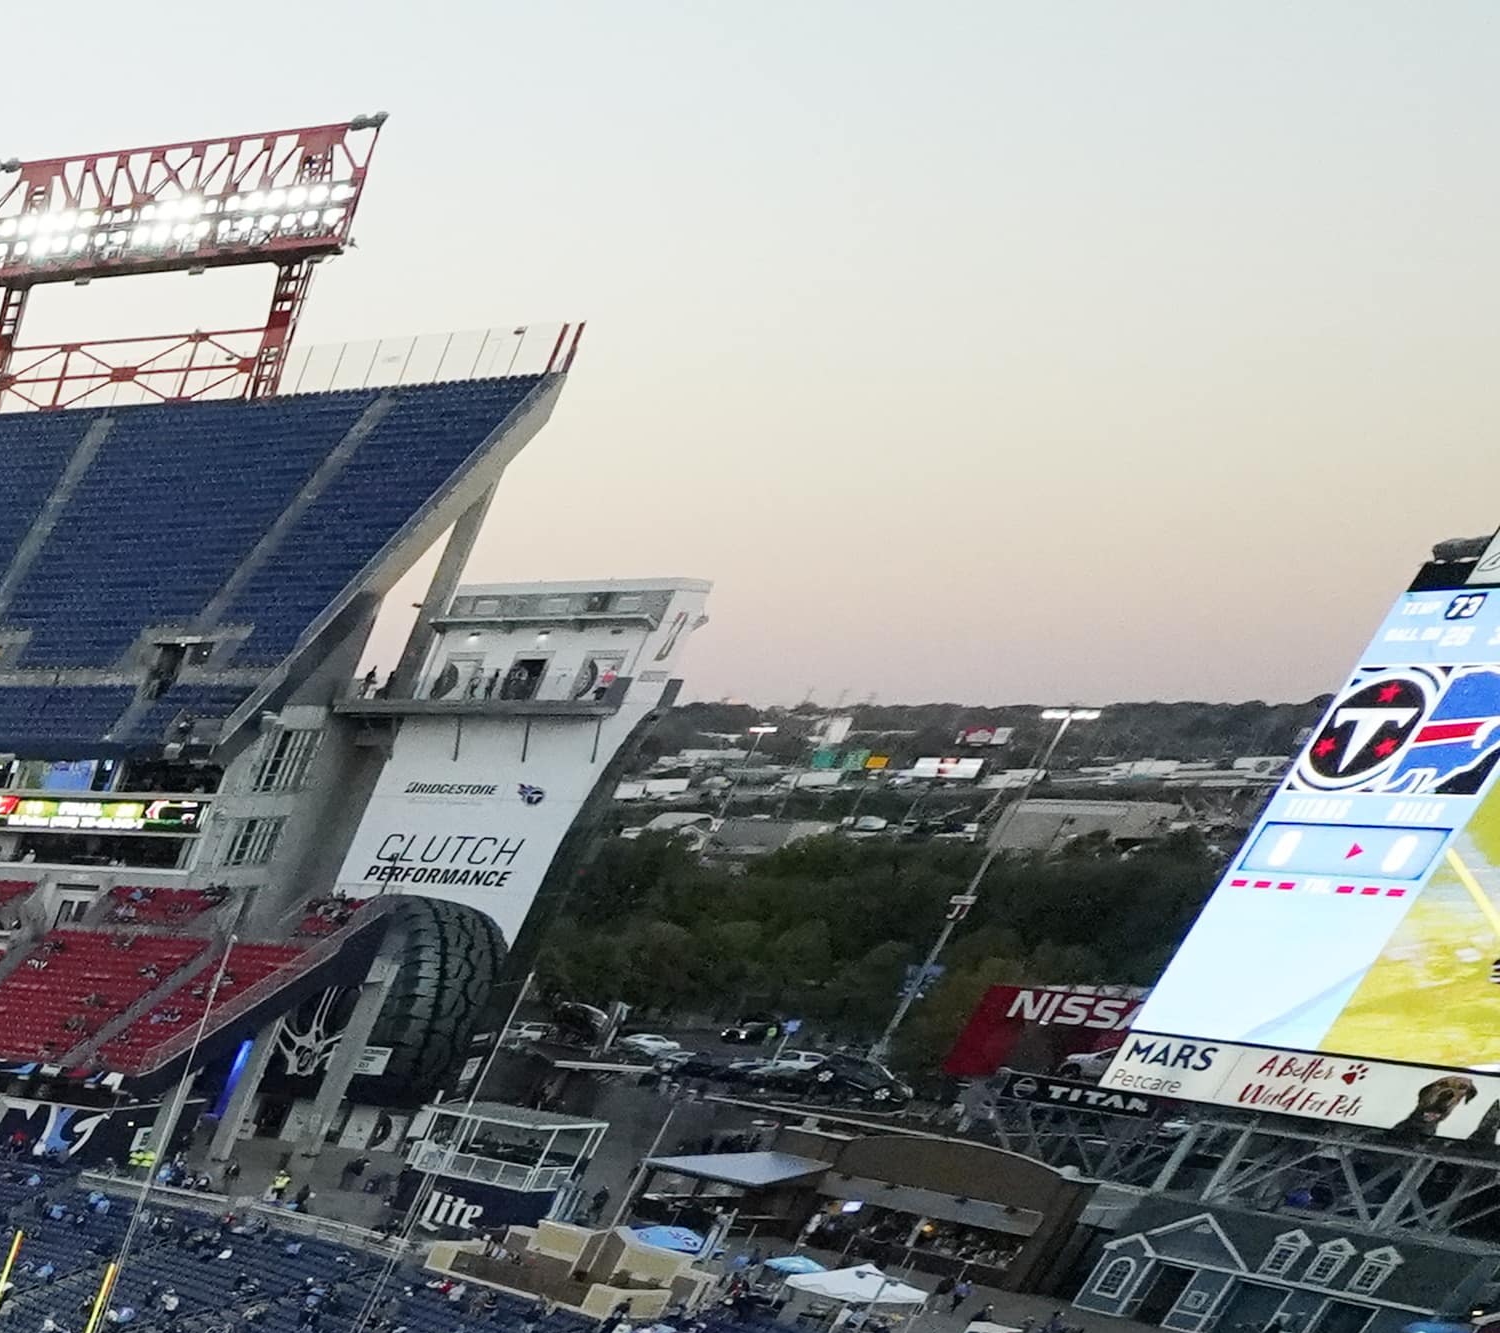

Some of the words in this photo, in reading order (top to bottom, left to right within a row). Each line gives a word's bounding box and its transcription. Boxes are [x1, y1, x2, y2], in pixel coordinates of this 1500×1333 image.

[1446, 594, 1485, 619] 73
[403, 781, 500, 797] BRIDGESTONE
[375, 833, 526, 866] CLUTCH
[363, 864, 514, 888] PERFORMANCE
[1124, 1038, 1220, 1073] MARS
[1257, 1053, 1278, 1076] A
[1276, 1055, 1335, 1083] Better
[1109, 1067, 1182, 1094] Petcare
[1238, 1082, 1301, 1113] World
[1325, 1093, 1364, 1119] Pets
[418, 1190, 485, 1232] Lite
